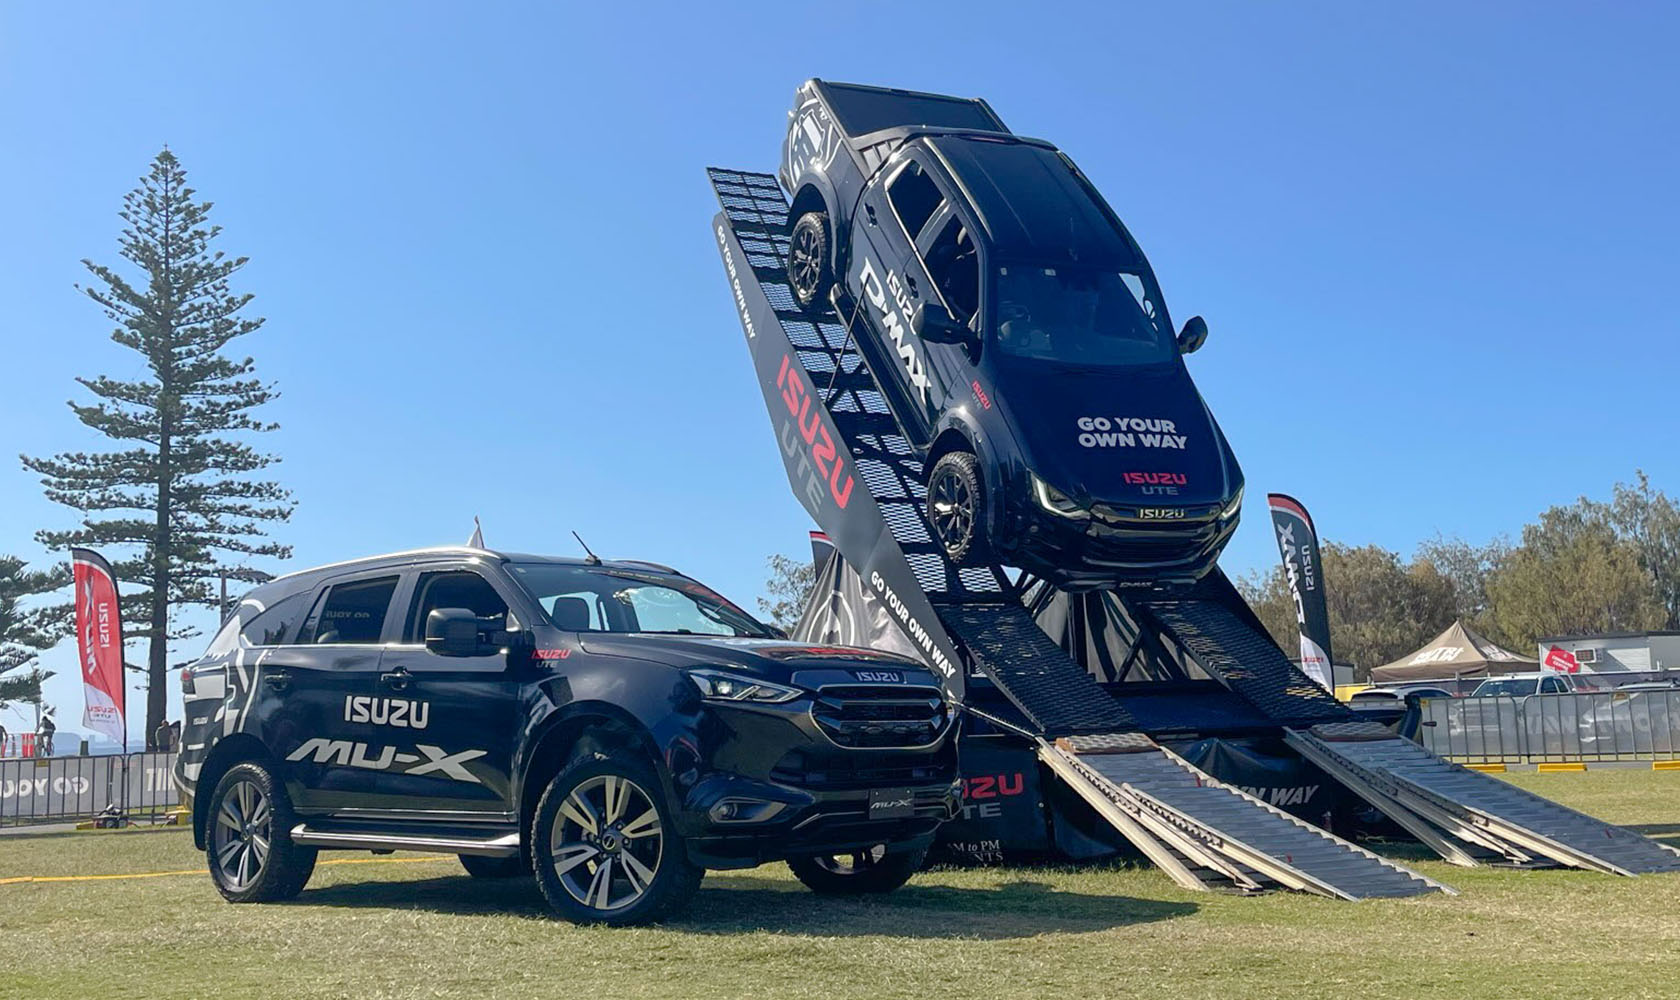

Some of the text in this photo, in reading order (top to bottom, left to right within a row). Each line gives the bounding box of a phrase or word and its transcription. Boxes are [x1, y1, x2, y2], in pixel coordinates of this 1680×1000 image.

[717, 225, 755, 338] GO YOUR OWN WAY
[972, 380, 991, 410] ISUZU
[776, 353, 854, 510] ISUZU
[1077, 417, 1177, 433] GO YOUR
[1078, 433, 1187, 449] OWN WAY
[781, 420, 825, 515] UTE
[1122, 472, 1187, 485] ISUZU
[1141, 486, 1179, 495] UTE
[1139, 508, 1185, 519] ISUZU
[871, 570, 957, 679] GO YOUR OWN WAY
[531, 648, 572, 659] ISUZU
[535, 660, 559, 668] UTE
[856, 671, 899, 682] ISUZU
[344, 695, 430, 729] ISUZU
[285, 737, 488, 783] MU-X
[1270, 784, 1320, 806] WAY
[962, 802, 1002, 819] TE
[980, 840, 1000, 851] PM
